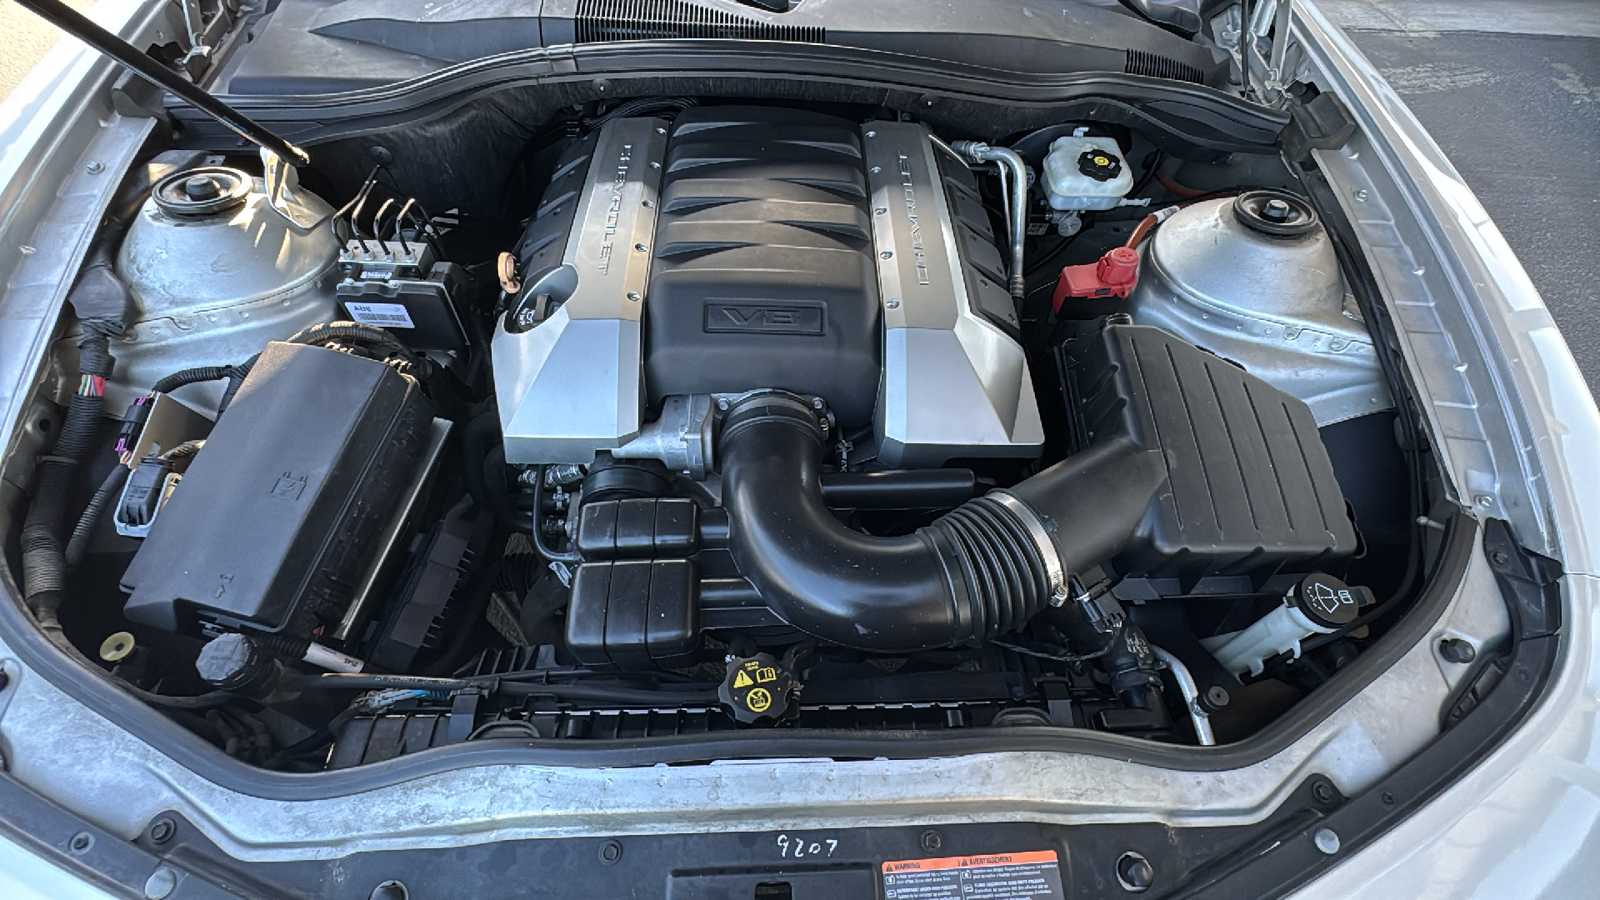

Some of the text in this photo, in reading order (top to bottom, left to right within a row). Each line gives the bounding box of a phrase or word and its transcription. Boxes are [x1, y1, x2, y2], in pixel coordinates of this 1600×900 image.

[597, 144, 632, 276] CHEVROLET
[897, 149, 930, 286] CHEVROLET
[777, 834, 838, 857] 9207
[894, 862, 921, 871] WARNING
[969, 856, 1013, 866] AVERTISSEMENT
